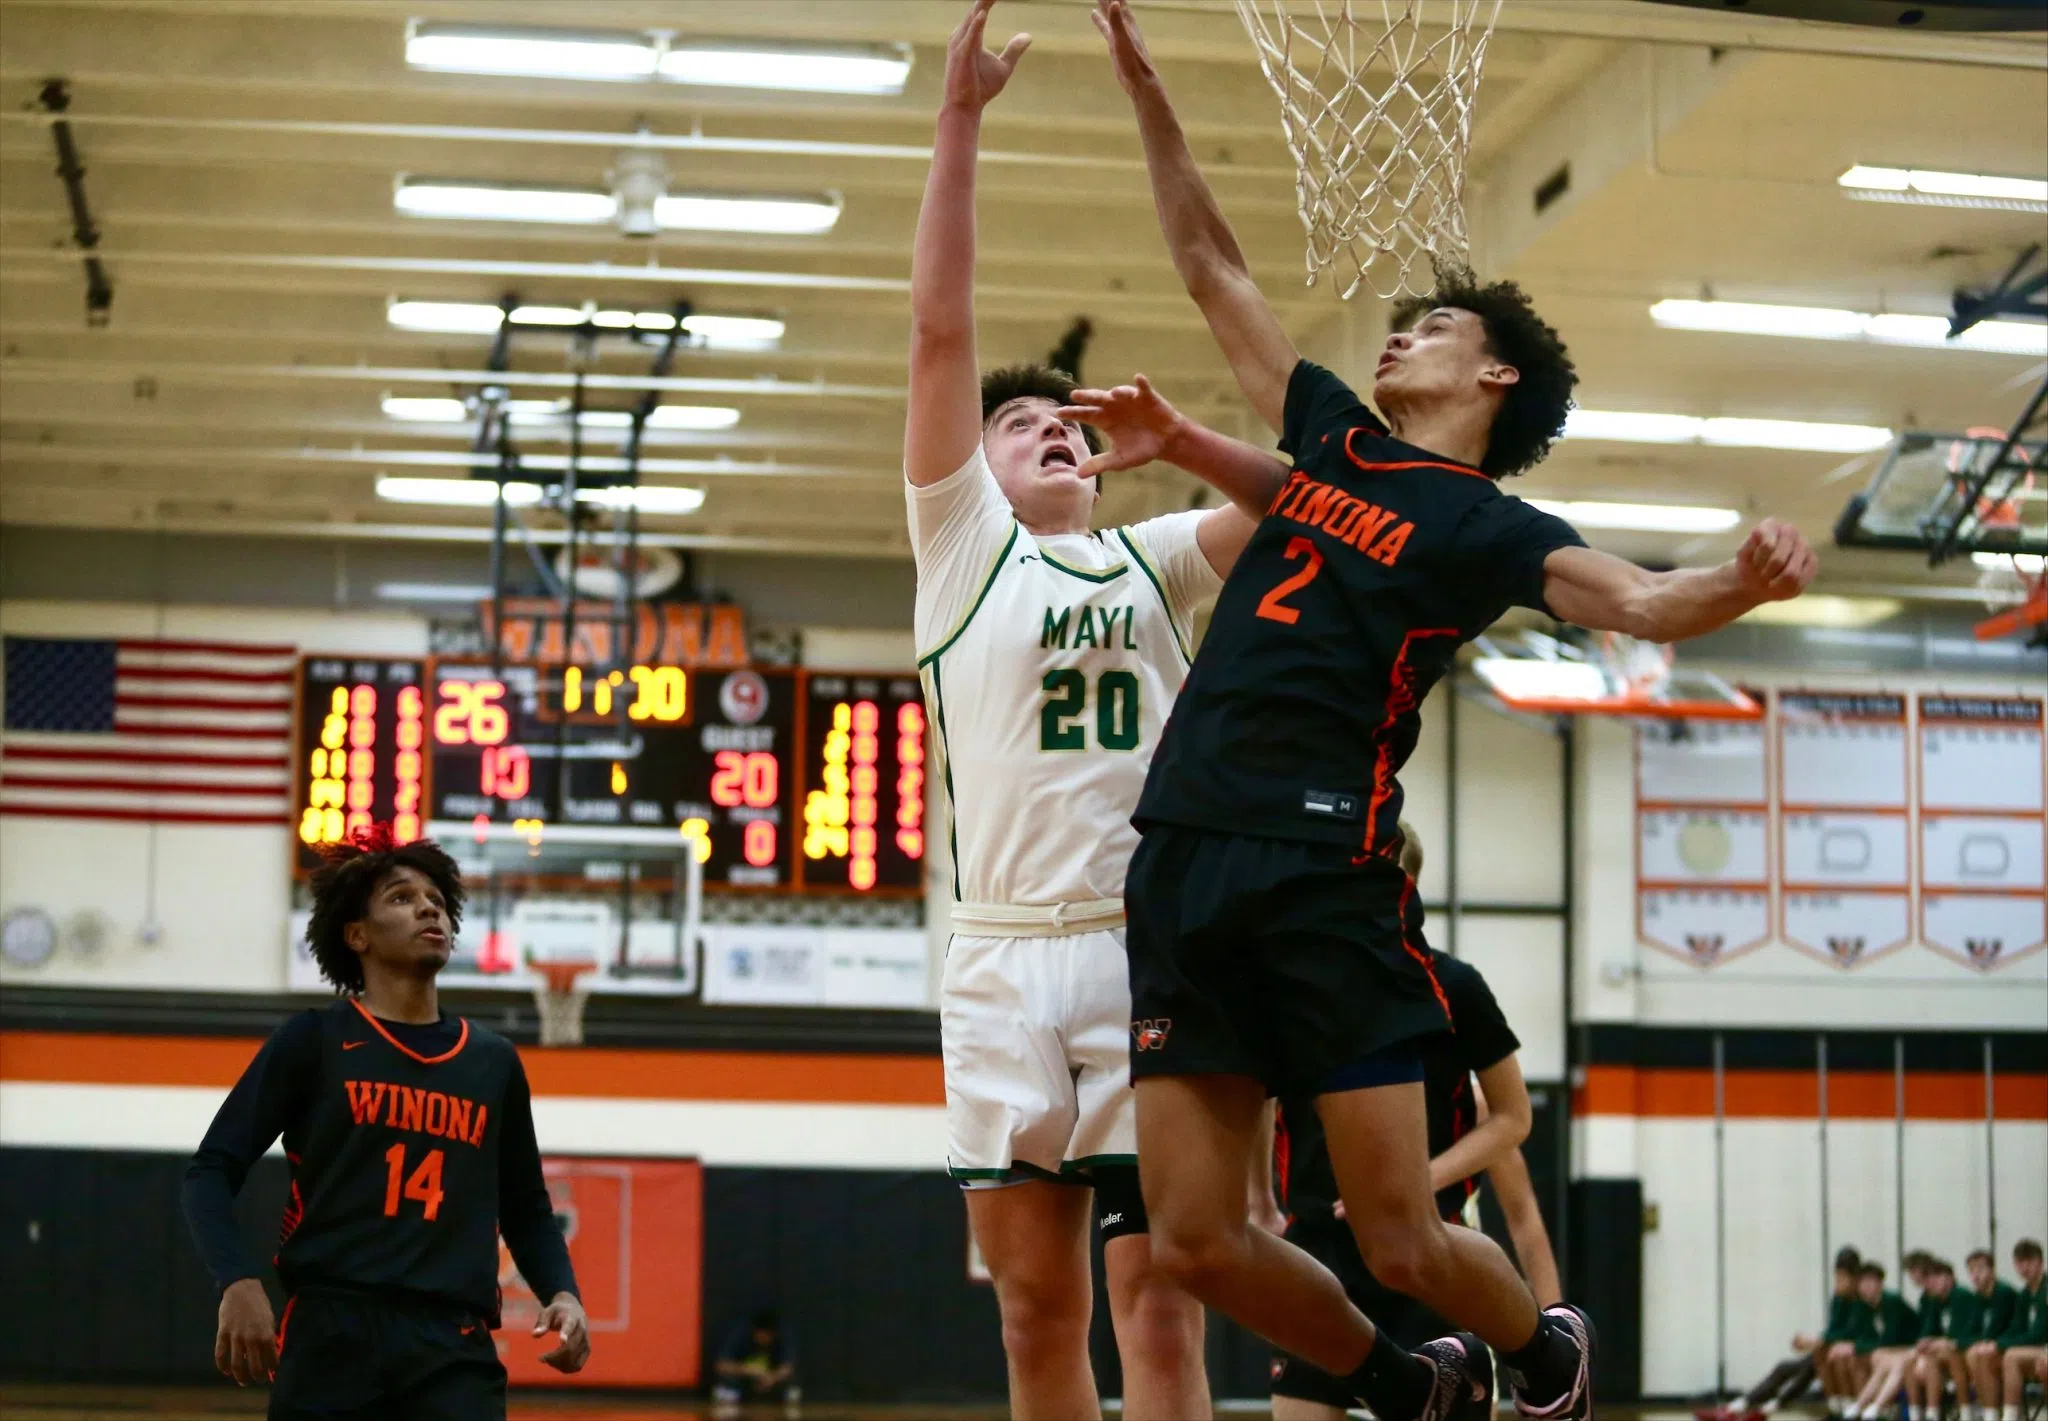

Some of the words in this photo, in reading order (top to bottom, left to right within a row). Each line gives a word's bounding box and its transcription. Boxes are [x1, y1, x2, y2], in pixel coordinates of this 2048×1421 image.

[1255, 536, 1324, 624] 2
[434, 680, 509, 745] 26
[1039, 667, 1141, 752] 20
[711, 750, 778, 806] 20
[1340, 801, 1351, 812] M
[744, 819, 776, 866] 0
[344, 1080, 488, 1149] WINONA
[383, 1143, 445, 1222] 14
